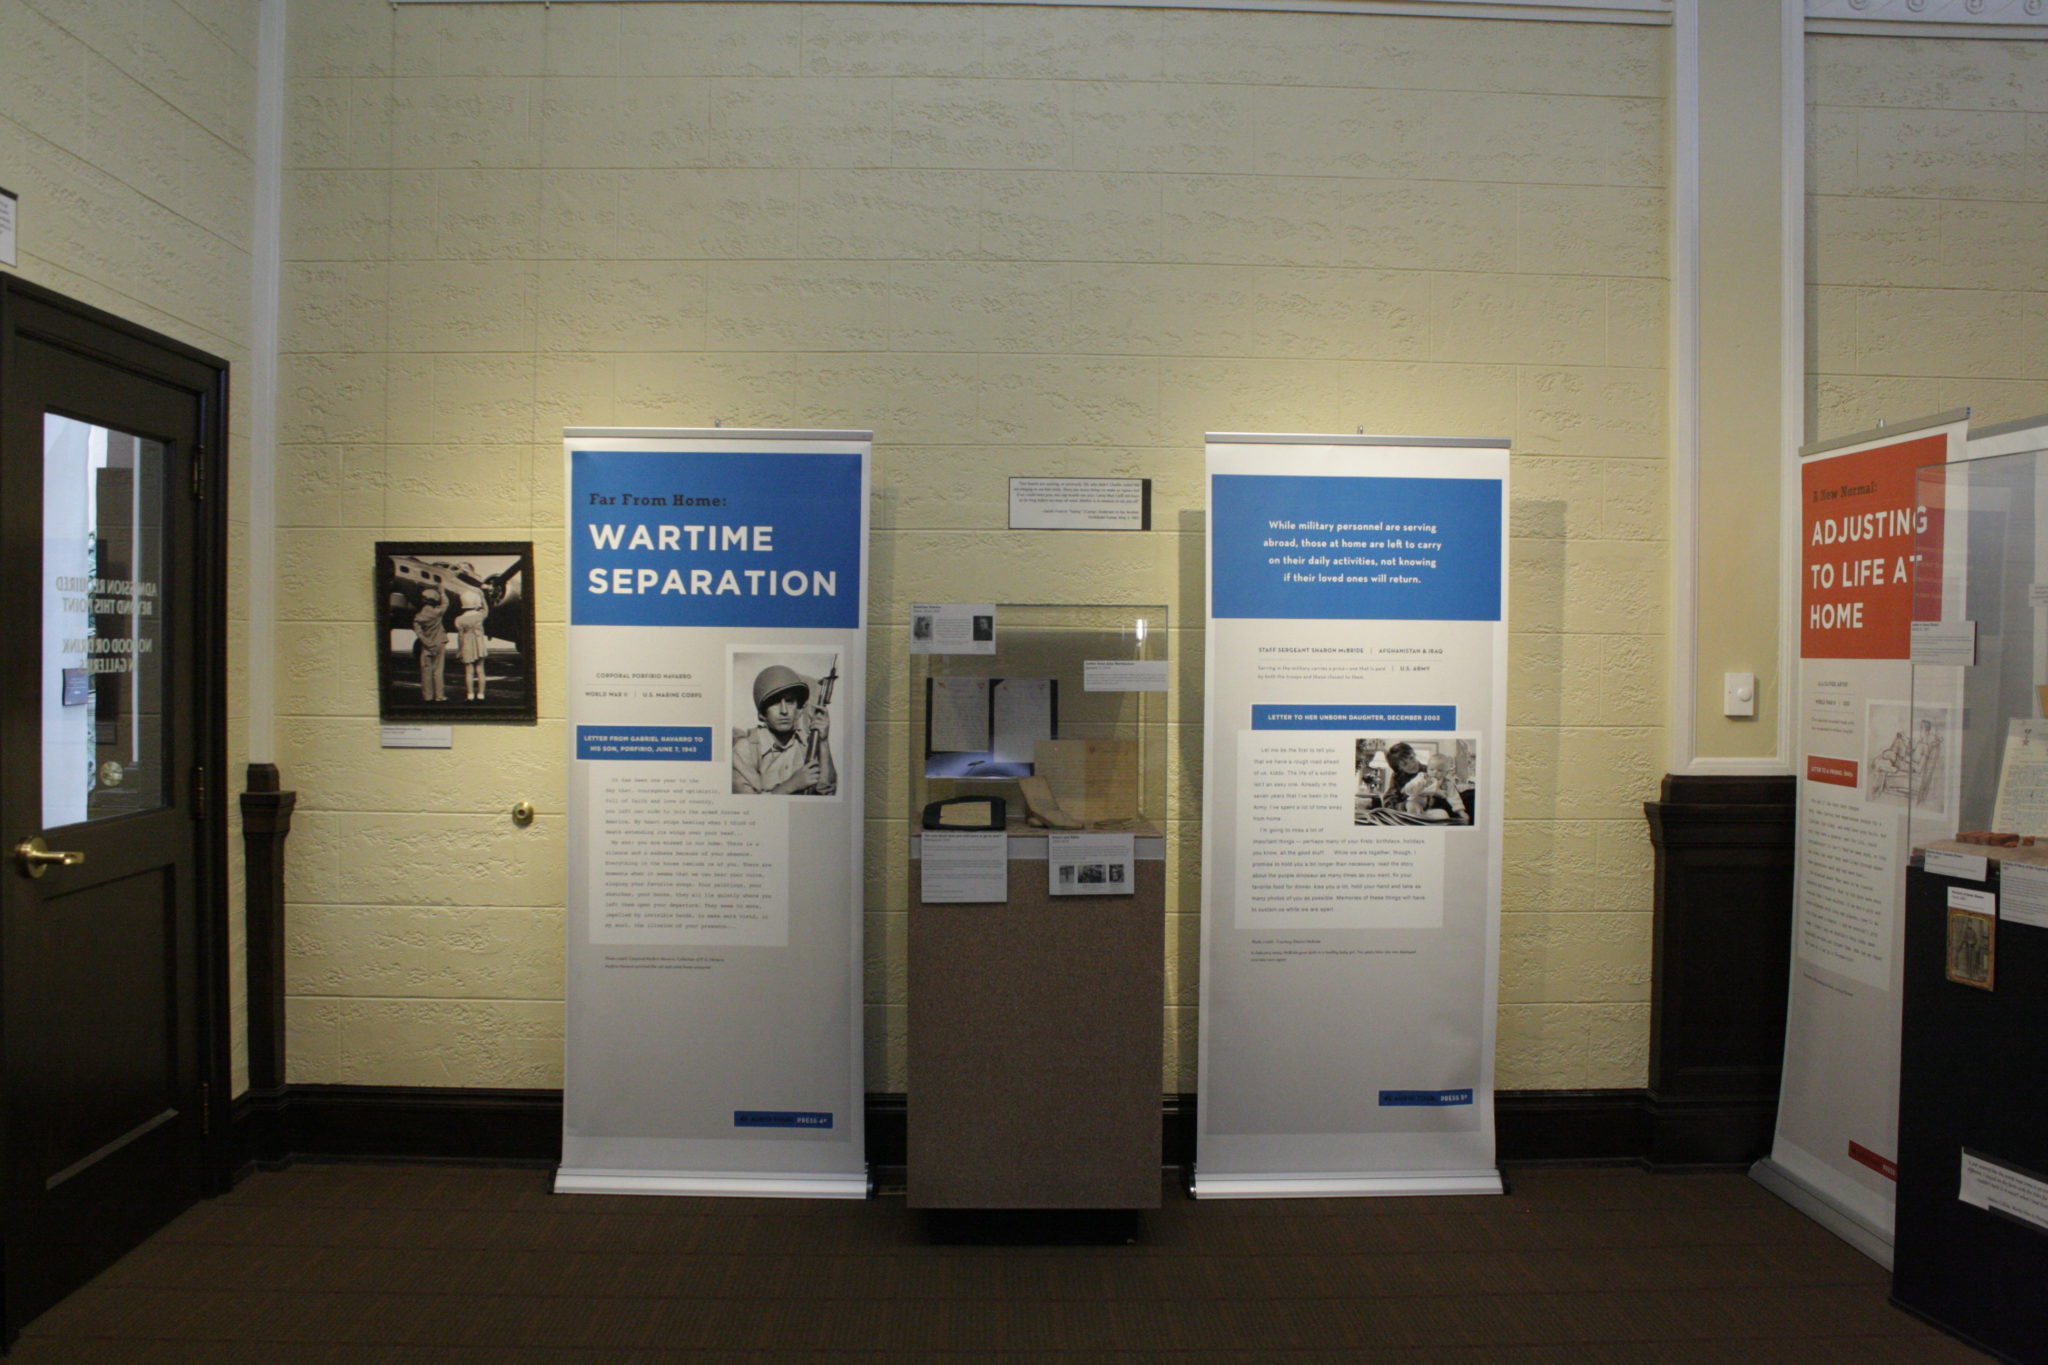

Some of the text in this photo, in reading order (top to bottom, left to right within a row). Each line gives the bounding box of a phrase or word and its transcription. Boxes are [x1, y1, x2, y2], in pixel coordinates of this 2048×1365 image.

[589, 493, 727, 507] Far From Home:
[1269, 521, 1295, 530] While
[1299, 521, 1333, 533] military
[1337, 522, 1383, 534] personnel
[1404, 522, 1437, 534] serving
[1811, 505, 1928, 547] ADJUSTING
[588, 524, 773, 551] WARTIME
[1263, 538, 1298, 550] abroad,
[1301, 539, 1327, 548] those
[1330, 539, 1339, 548] at
[1341, 539, 1367, 548] home
[1387, 539, 1402, 549] left
[1405, 540, 1415, 549] to
[1417, 542, 1442, 552] carry
[1283, 555, 1304, 565] their
[1309, 556, 1329, 568] daily
[1334, 556, 1377, 568] activities,
[1381, 557, 1395, 566] not
[1399, 557, 1436, 569] knowing
[588, 568, 836, 596] SEPARATION
[1283, 573, 1422, 583] if their loved ones will return.
[1811, 562, 1835, 589] TO
[1842, 558, 1885, 588] LIFE
[1810, 602, 1863, 629] HOME
